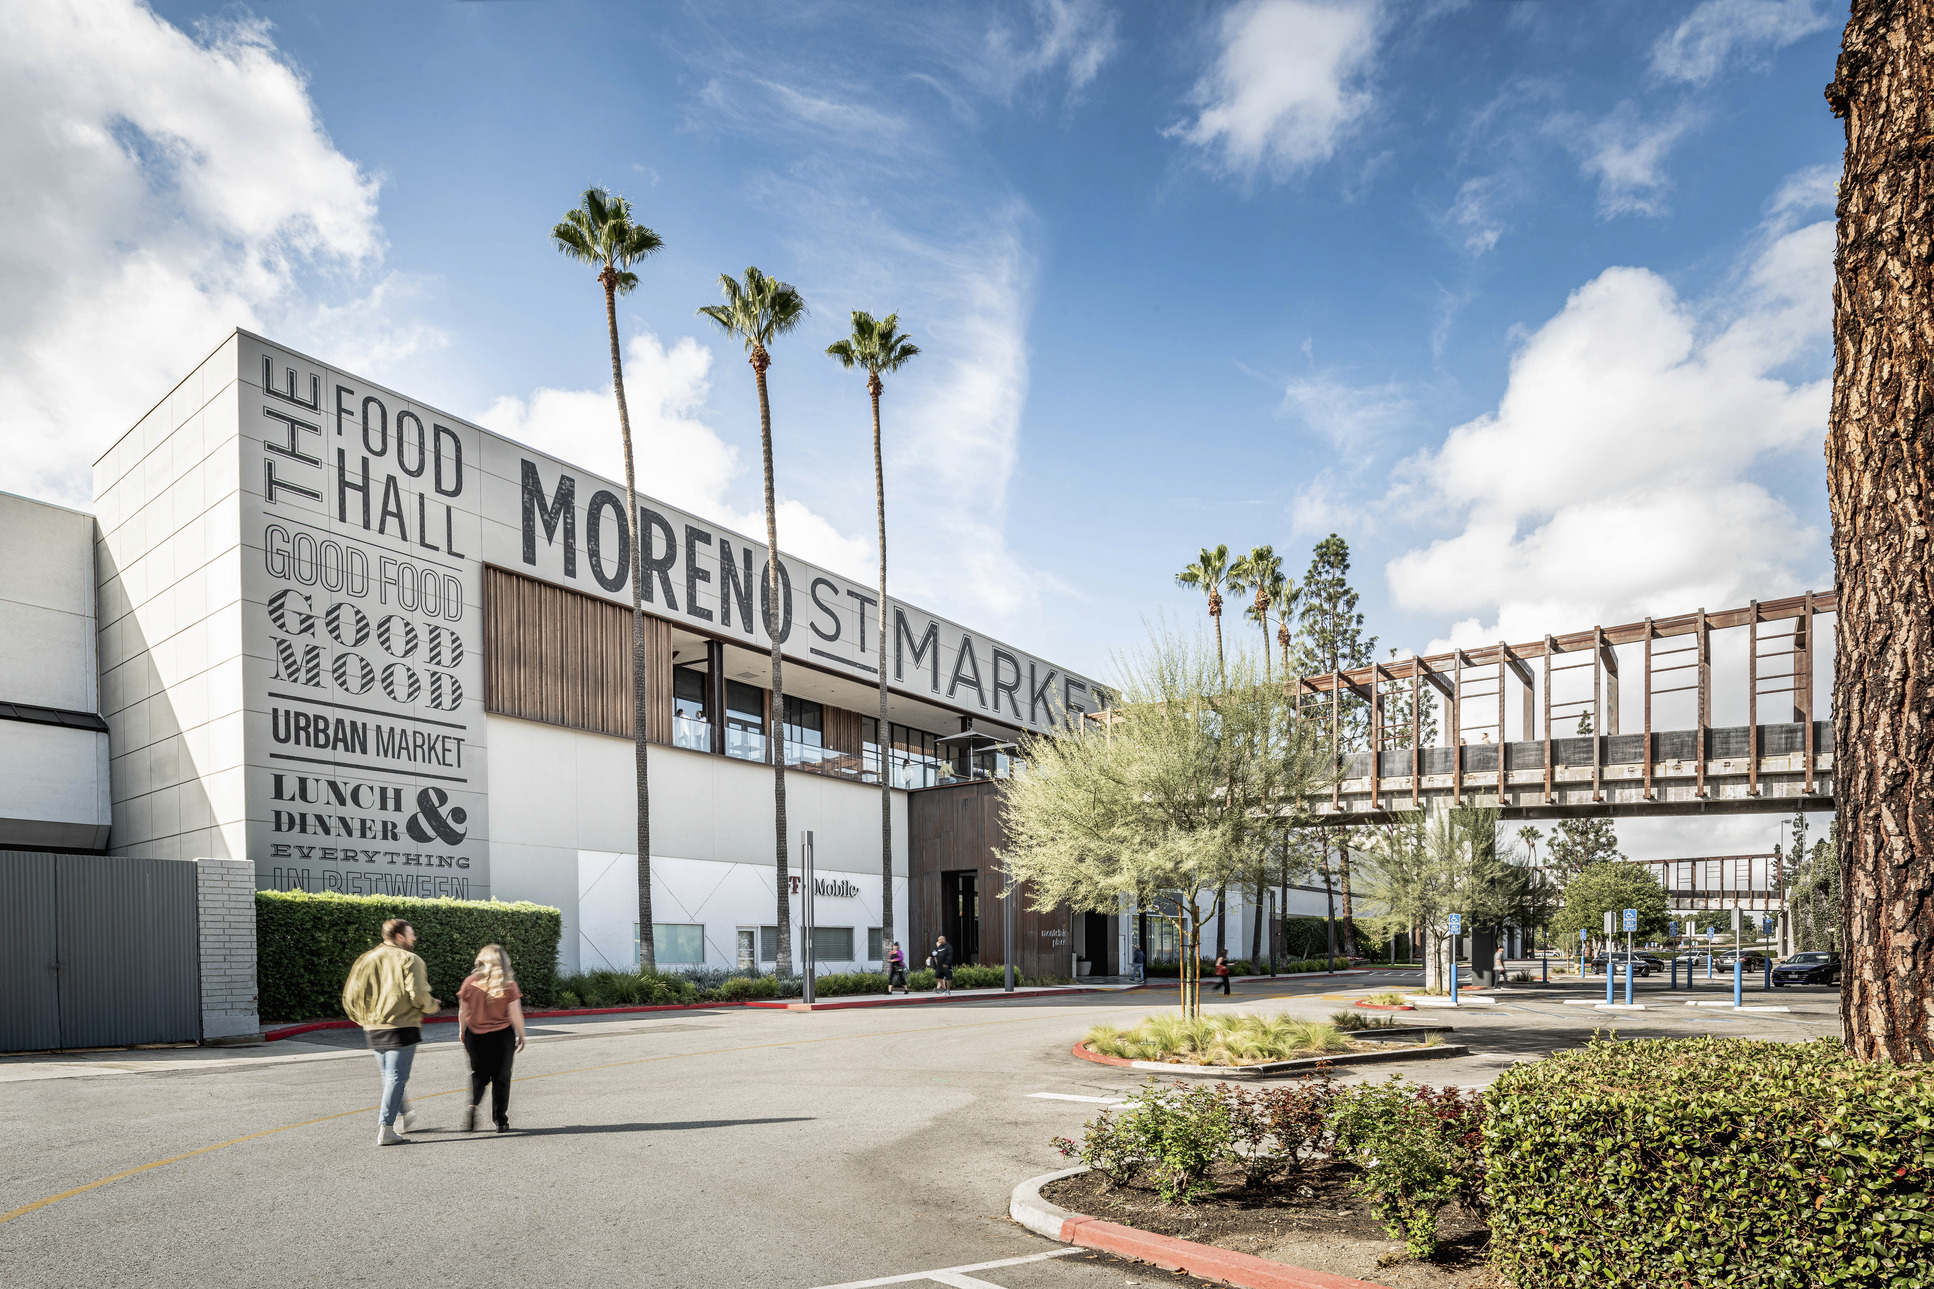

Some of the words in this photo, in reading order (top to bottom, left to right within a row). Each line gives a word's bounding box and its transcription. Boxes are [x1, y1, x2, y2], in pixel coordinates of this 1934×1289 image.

[262, 354, 323, 505] THE
[336, 384, 463, 498] FOOD
[337, 447, 465, 559] HALL
[265, 524, 369, 598] GOOD
[380, 555, 463, 622] FOOD
[521, 458, 793, 645] MORENO
[809, 577, 878, 653] ST
[267, 589, 464, 668] GOOD
[268, 636, 464, 711] MOOD
[271, 707, 368, 755] URBAN
[375, 724, 466, 768] MARKET
[270, 773, 404, 813] LUNCH
[270, 810, 401, 842] DINNER
[270, 843, 471, 869] EVERYTHING
[273, 867, 310, 893] IN
[322, 869, 469, 900] BETWEEN
